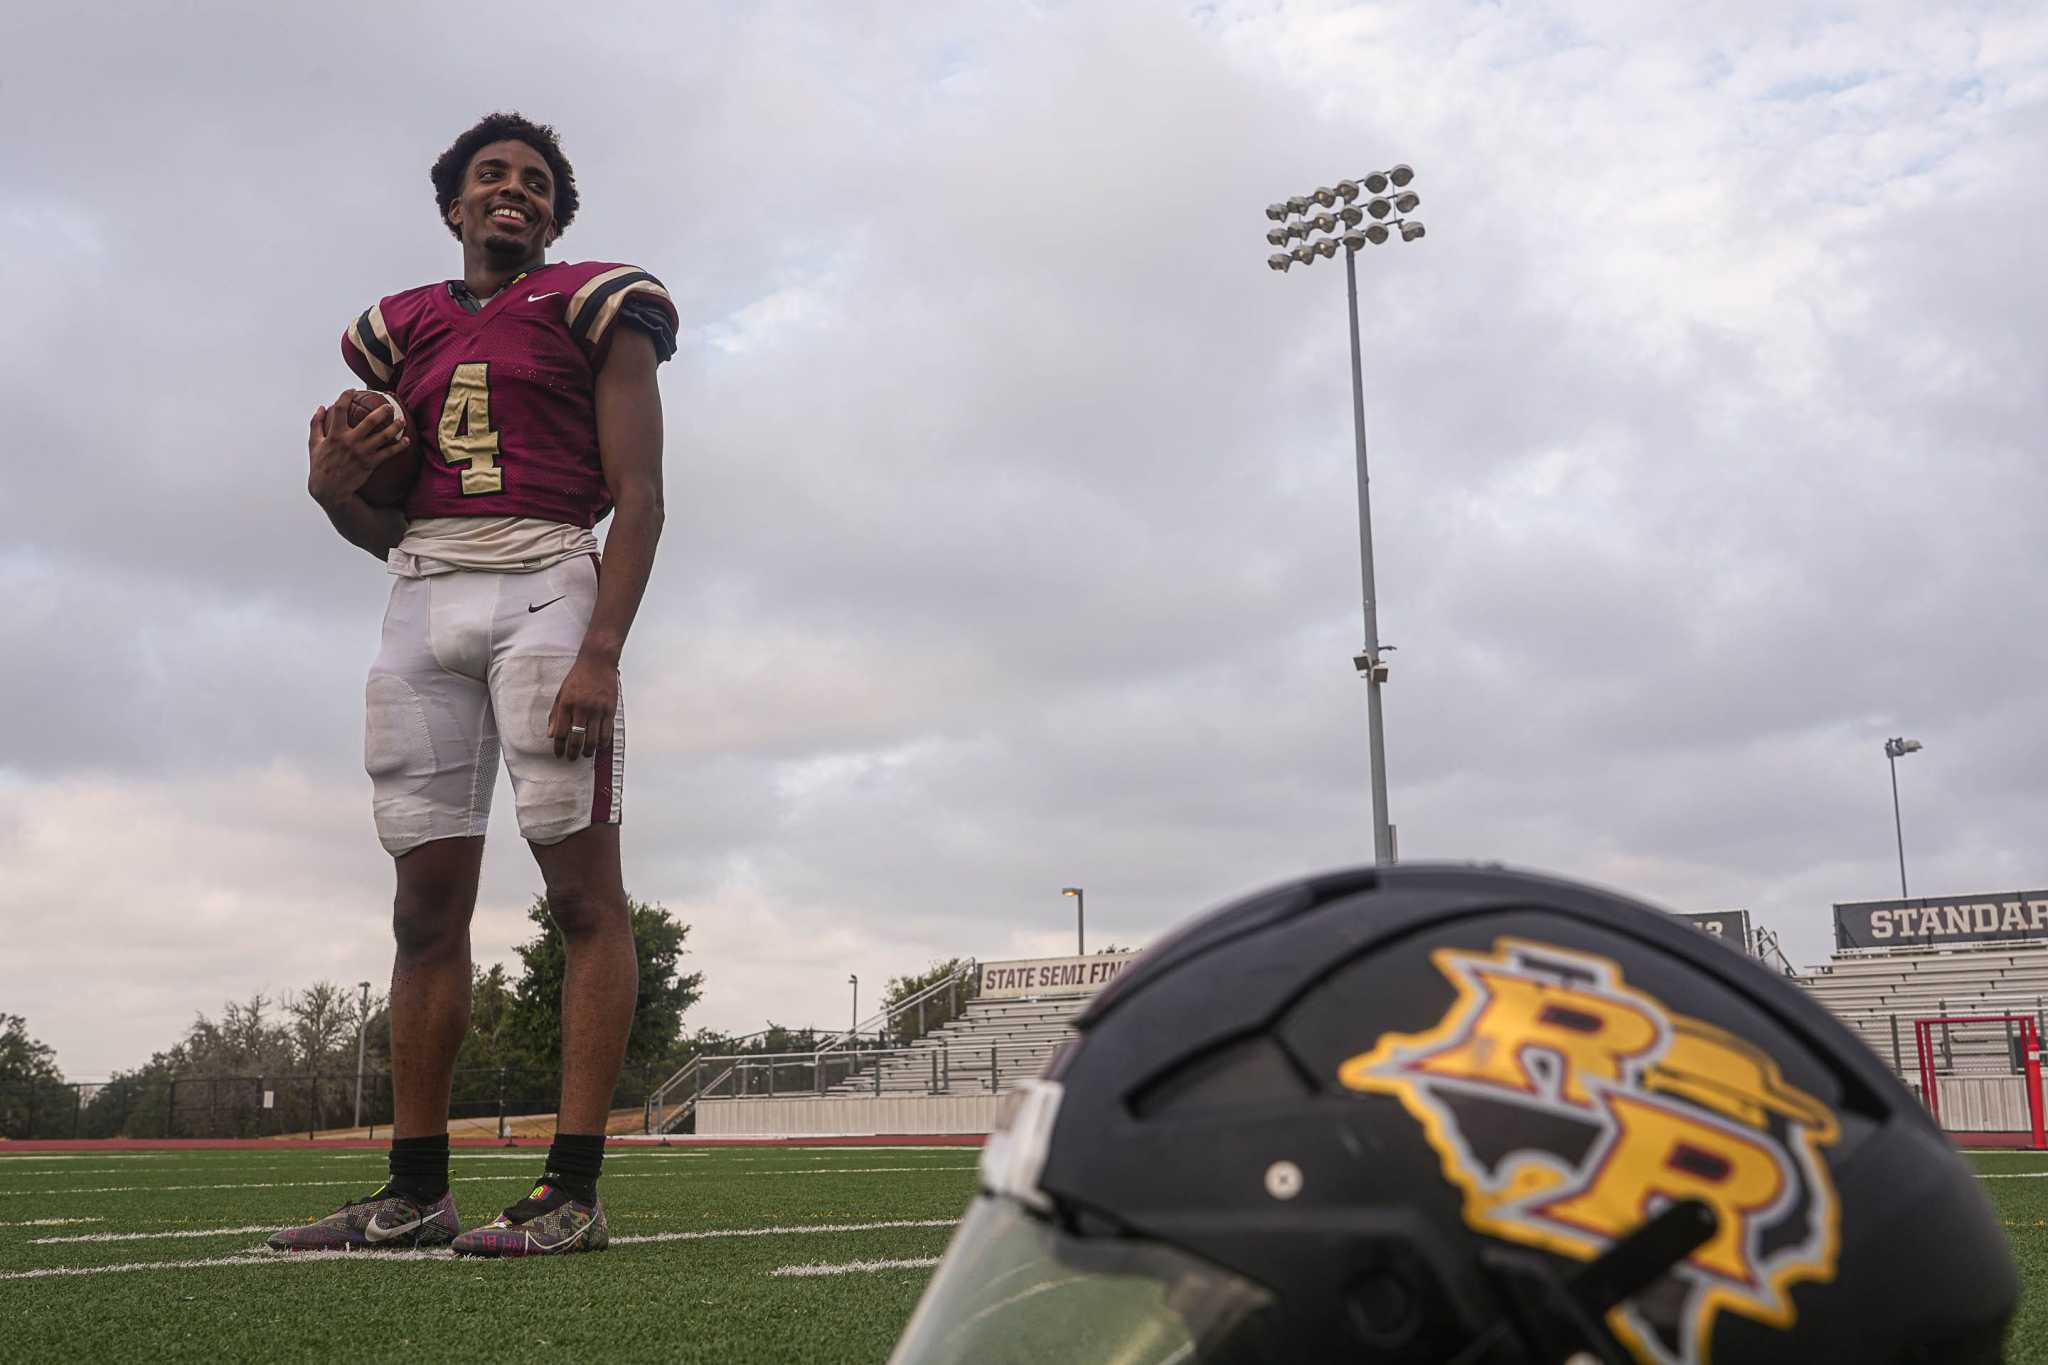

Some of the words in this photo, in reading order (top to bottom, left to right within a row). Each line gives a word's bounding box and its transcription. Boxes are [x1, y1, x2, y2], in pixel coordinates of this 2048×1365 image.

[437, 362, 504, 497] 4
[985, 967, 1036, 990] STATE
[1039, 963, 1087, 987] SEMI
[1090, 960, 1131, 984] FIN
